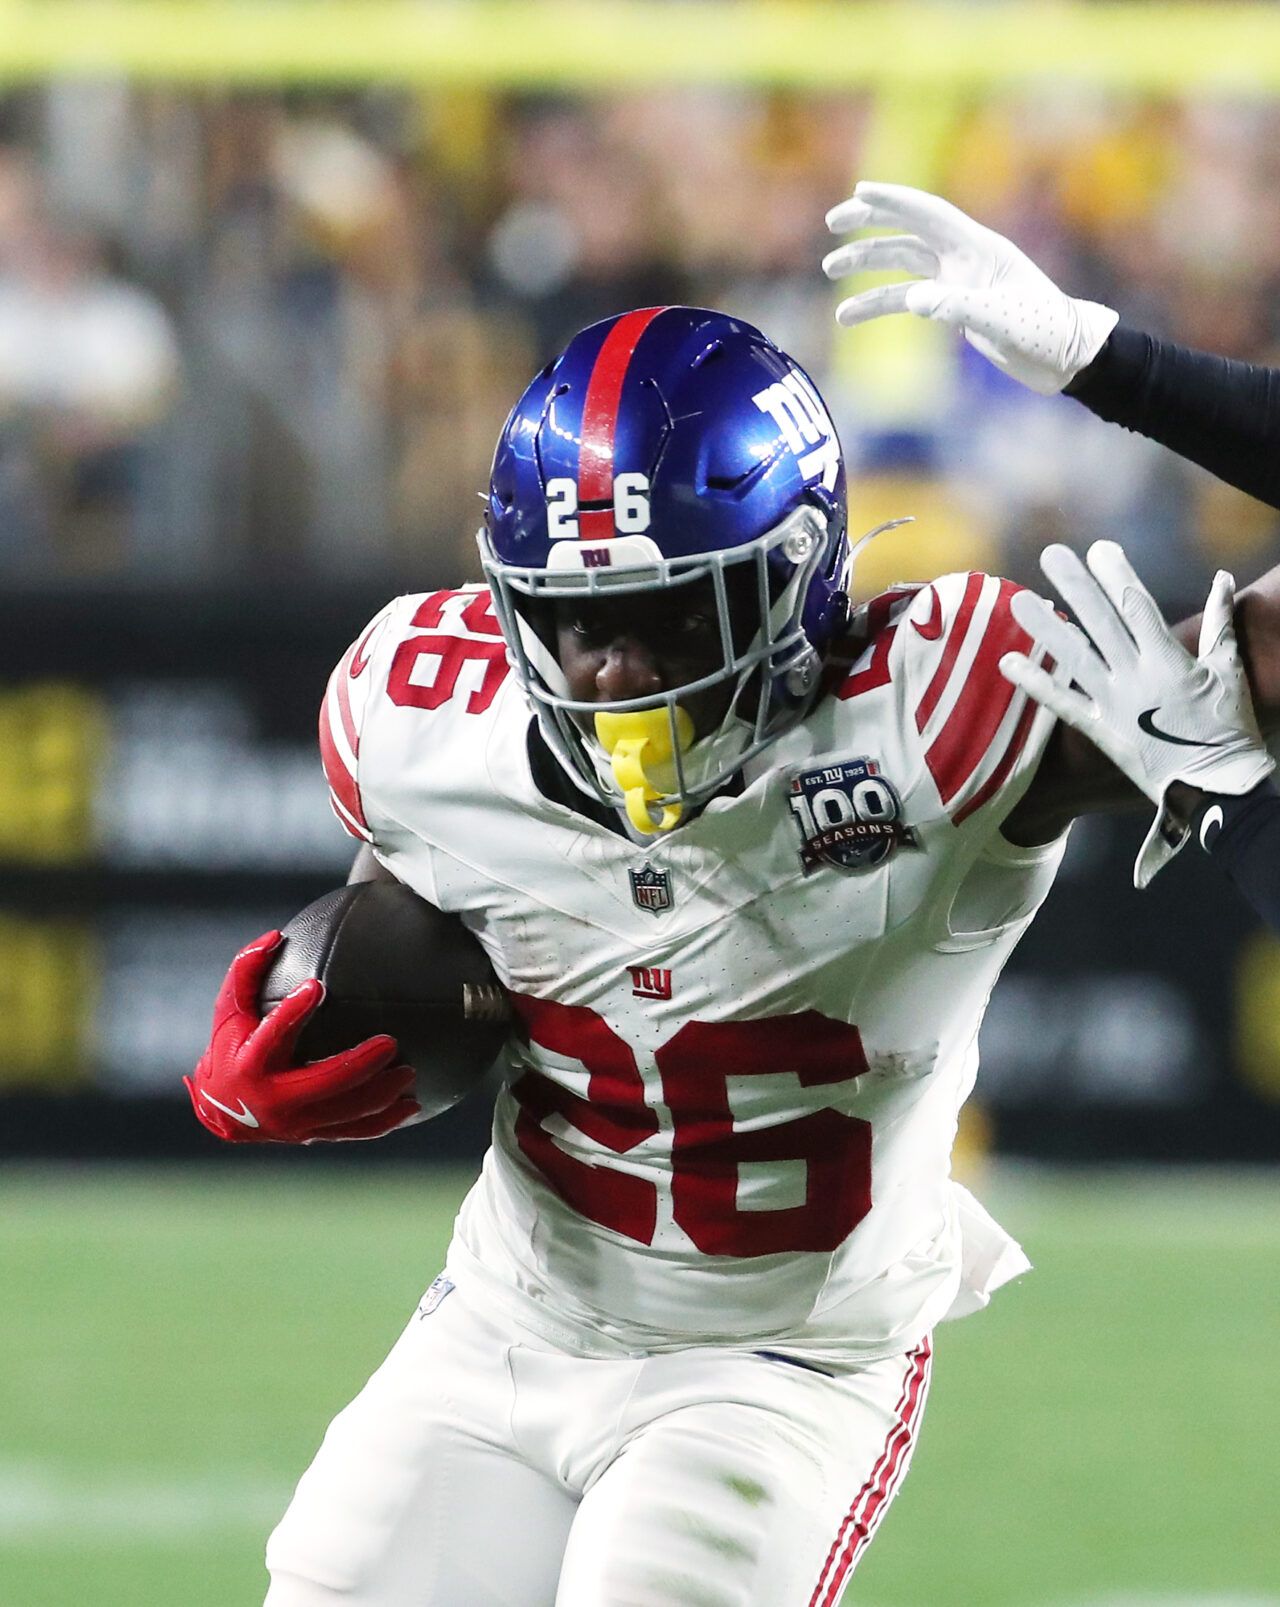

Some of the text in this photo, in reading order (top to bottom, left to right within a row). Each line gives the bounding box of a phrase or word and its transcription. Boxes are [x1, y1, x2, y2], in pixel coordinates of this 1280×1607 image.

[804, 777, 824, 786] EST.
[789, 779, 896, 840] 100
[812, 824, 894, 849] SEASONS
[636, 888, 667, 908] NFL
[510, 992, 873, 1258] 26
